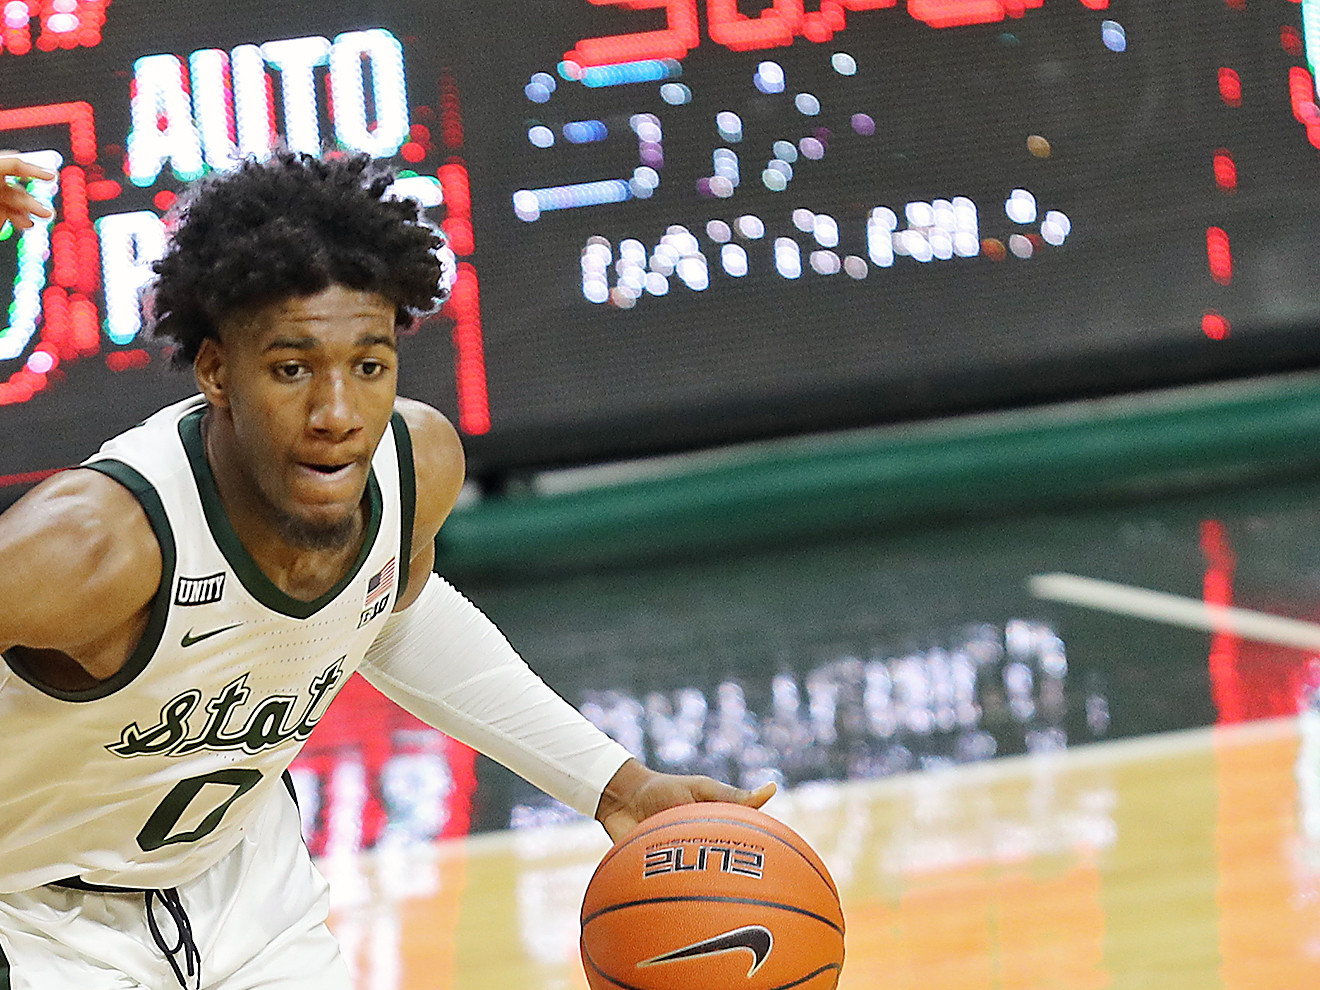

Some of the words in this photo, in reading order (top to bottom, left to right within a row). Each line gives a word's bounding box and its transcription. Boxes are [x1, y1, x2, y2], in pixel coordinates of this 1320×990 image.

[127, 27, 411, 187] AUTO
[177, 573, 225, 604] UNITY
[136, 768, 264, 852] 0
[643, 845, 765, 880] ELITE
